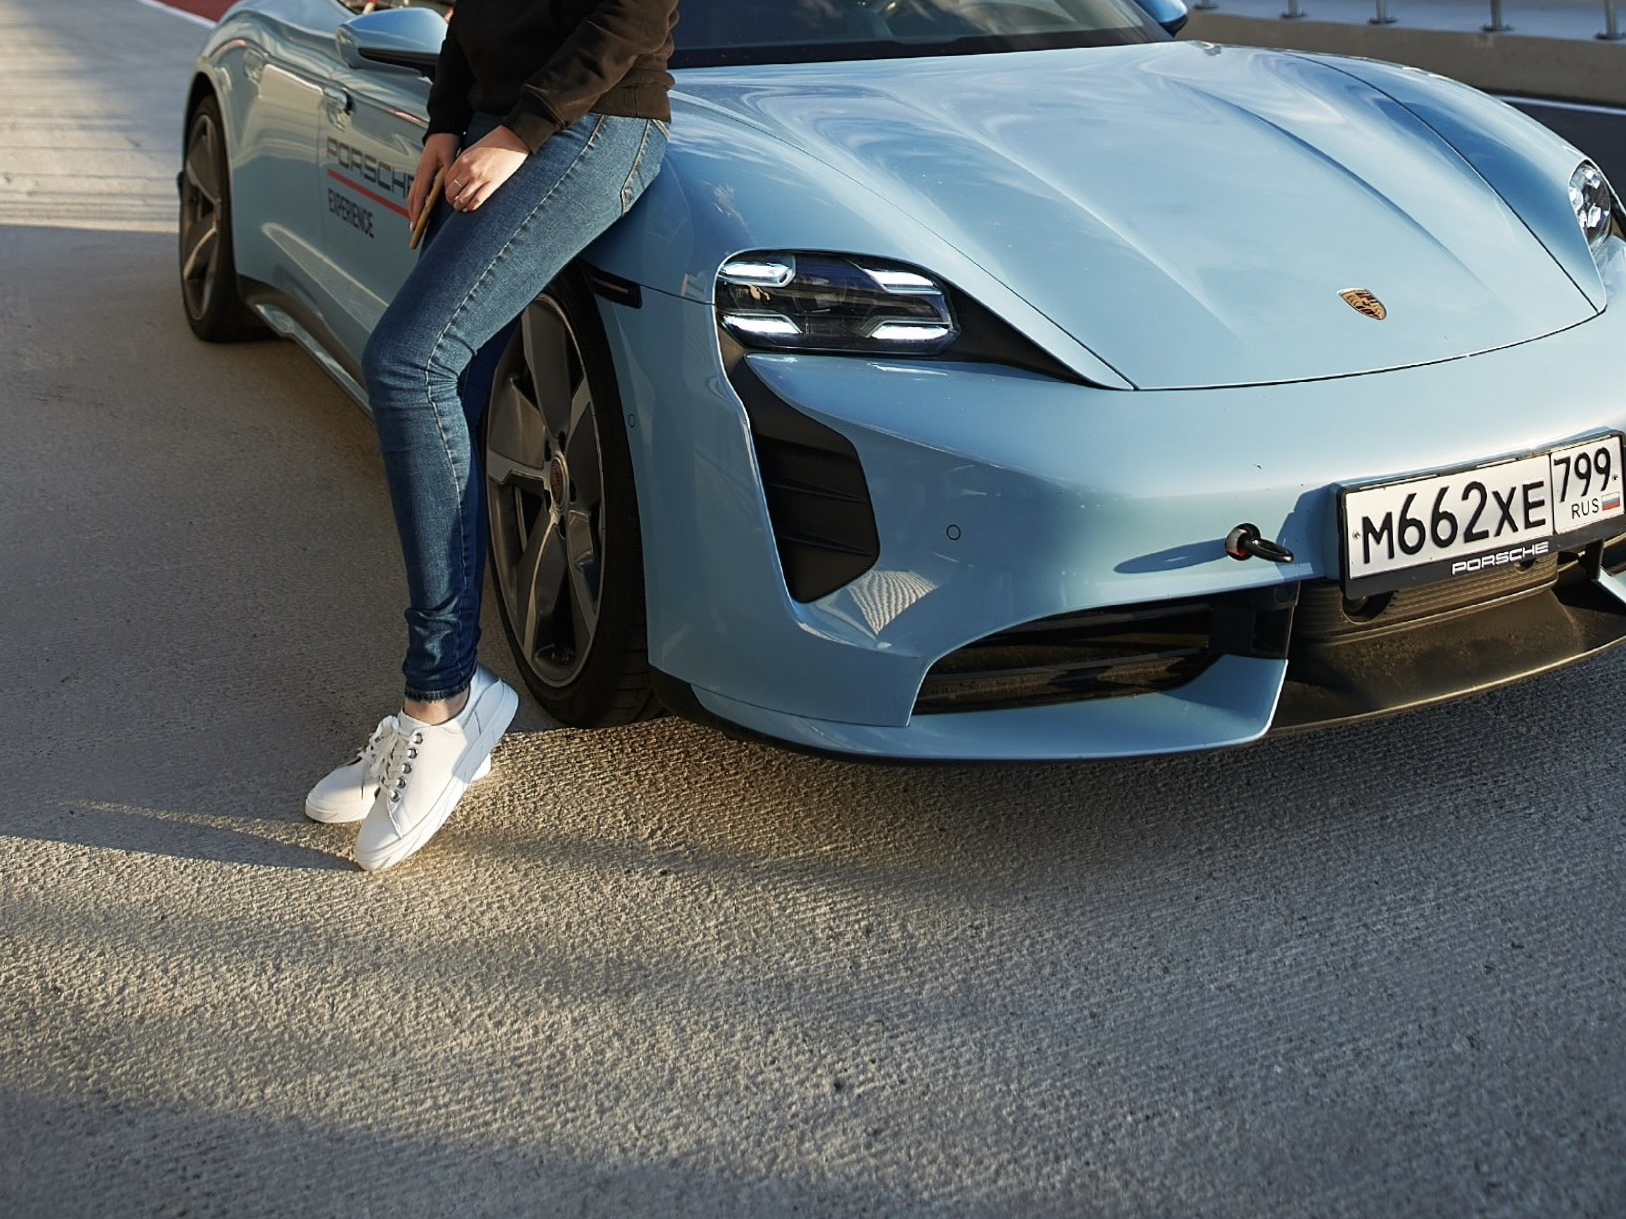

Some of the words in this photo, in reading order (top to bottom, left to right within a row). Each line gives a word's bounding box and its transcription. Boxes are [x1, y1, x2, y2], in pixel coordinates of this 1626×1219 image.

[328, 188, 375, 239] EXPERIENCE
[1553, 446, 1612, 504] 799
[1571, 497, 1600, 520] RUS
[1451, 540, 1549, 576] PORSCHE
